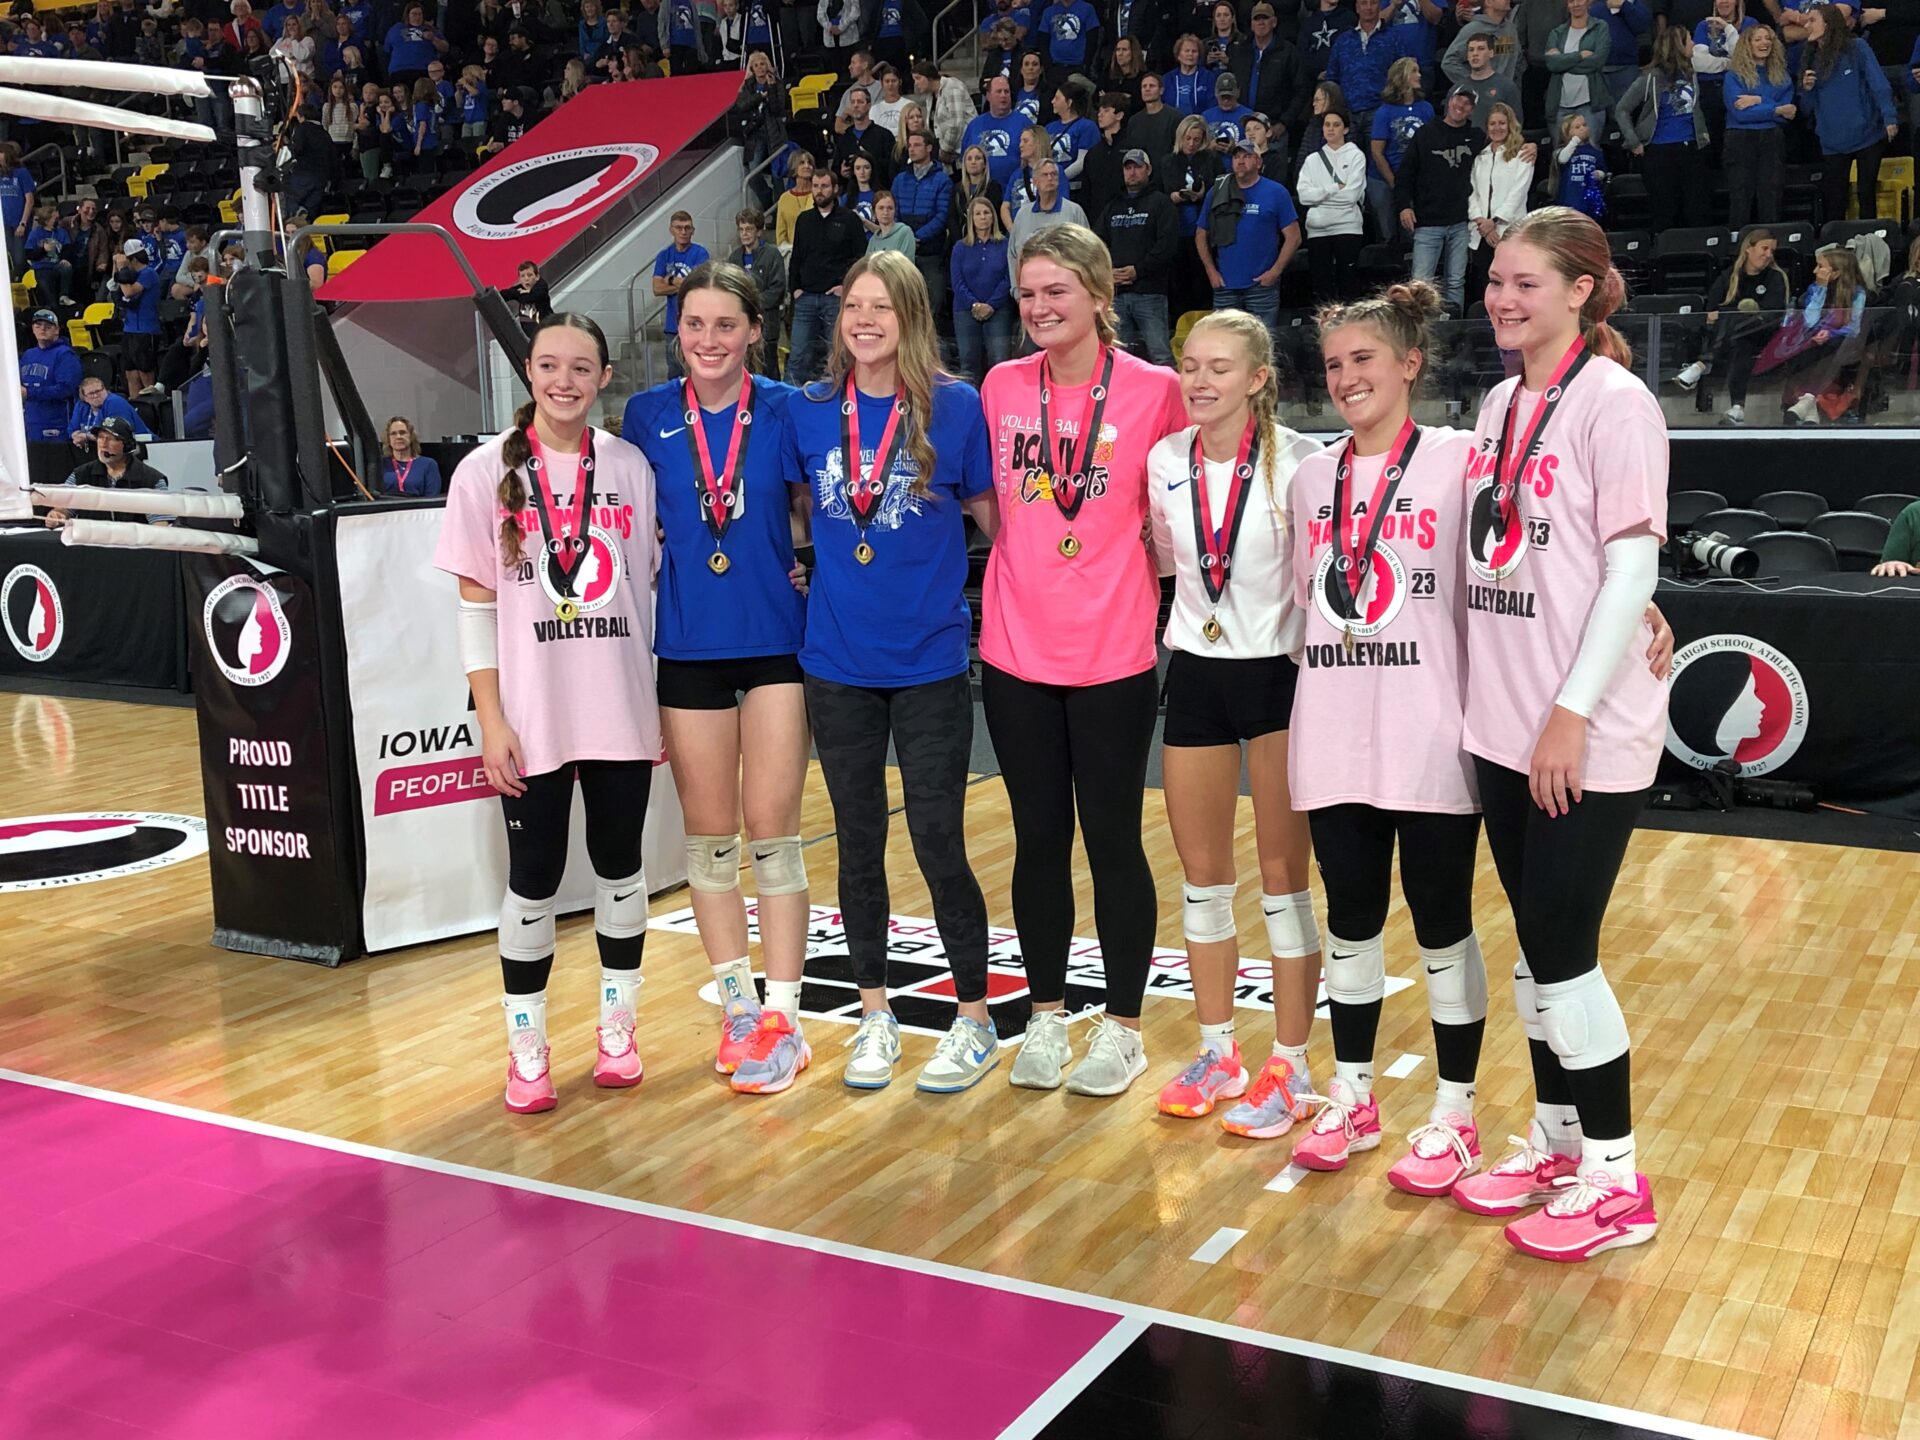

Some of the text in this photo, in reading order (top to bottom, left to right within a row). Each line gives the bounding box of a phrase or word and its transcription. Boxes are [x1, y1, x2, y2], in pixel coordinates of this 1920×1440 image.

[1000, 414, 1080, 435] VOLLEBAL
[1317, 498, 1413, 520] SAE
[1528, 521, 1550, 546] 23
[1411, 572, 1436, 595] 23
[1467, 584, 1537, 618] LLEYBALL
[533, 617, 631, 643] VOLLEYBALL
[1306, 641, 1421, 669] VOLLEYBALL
[225, 669, 257, 684] FOUNDED
[1680, 642, 1709, 661] HIGH
[1710, 639, 1756, 652] SCHOOL
[1757, 647, 1801, 691] ATHLETIC
[1793, 691, 1804, 727] UNION
[229, 737, 292, 767] PROUD
[378, 723, 475, 760] IOWA
[1746, 761, 1768, 775] 1927
[236, 783, 290, 812] TITLE
[225, 826, 312, 859] SPONSOR
